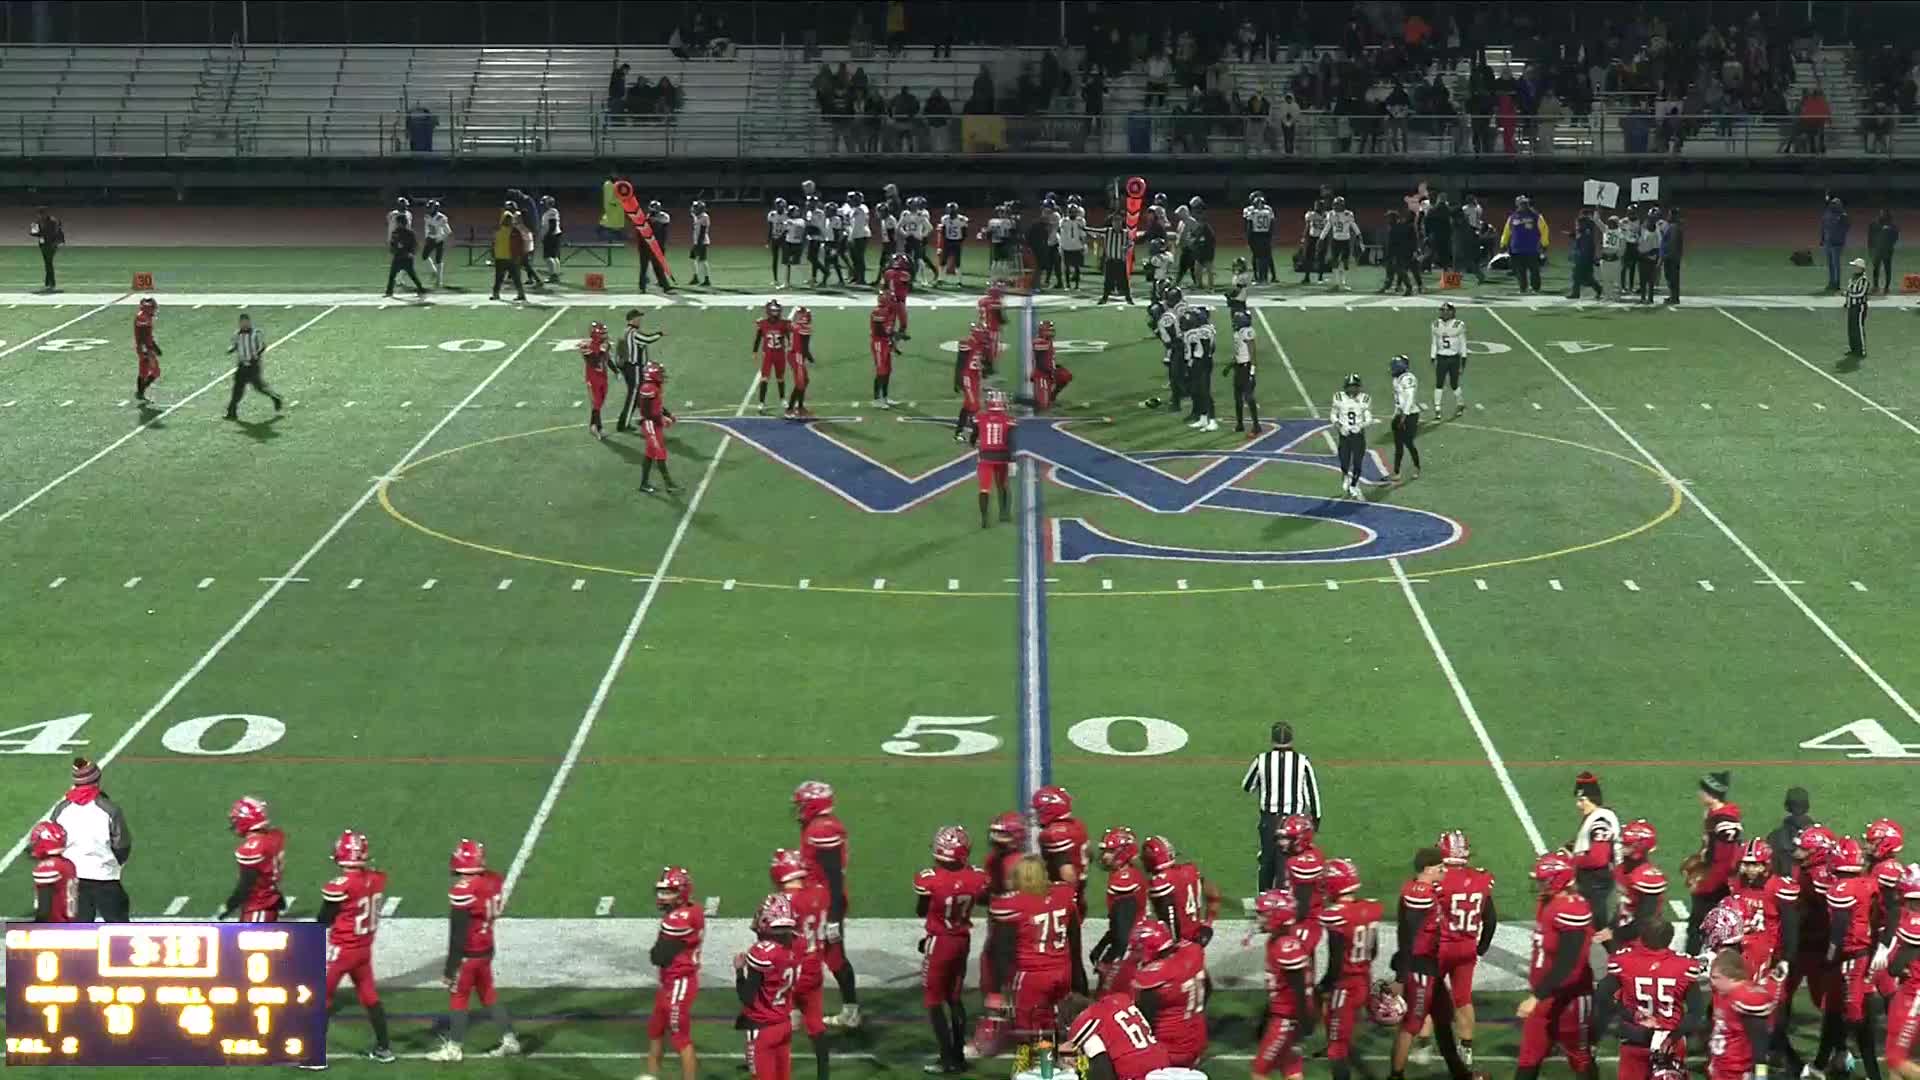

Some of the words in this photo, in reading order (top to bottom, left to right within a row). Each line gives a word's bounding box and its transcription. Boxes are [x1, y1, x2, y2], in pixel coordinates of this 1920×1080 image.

[1640, 182, 1650, 195] R
[137, 275, 153, 287] 30
[1441, 335, 1451, 349] 5
[1347, 410, 1357, 425] 9
[1032, 908, 1067, 954] 75
[1448, 892, 1484, 941] 52
[36, 951, 58, 982] 0
[247, 952, 270, 983] 0
[1635, 976, 1677, 1017] 55
[42, 1004, 59, 1033] 1
[253, 1005, 270, 1034] 1
